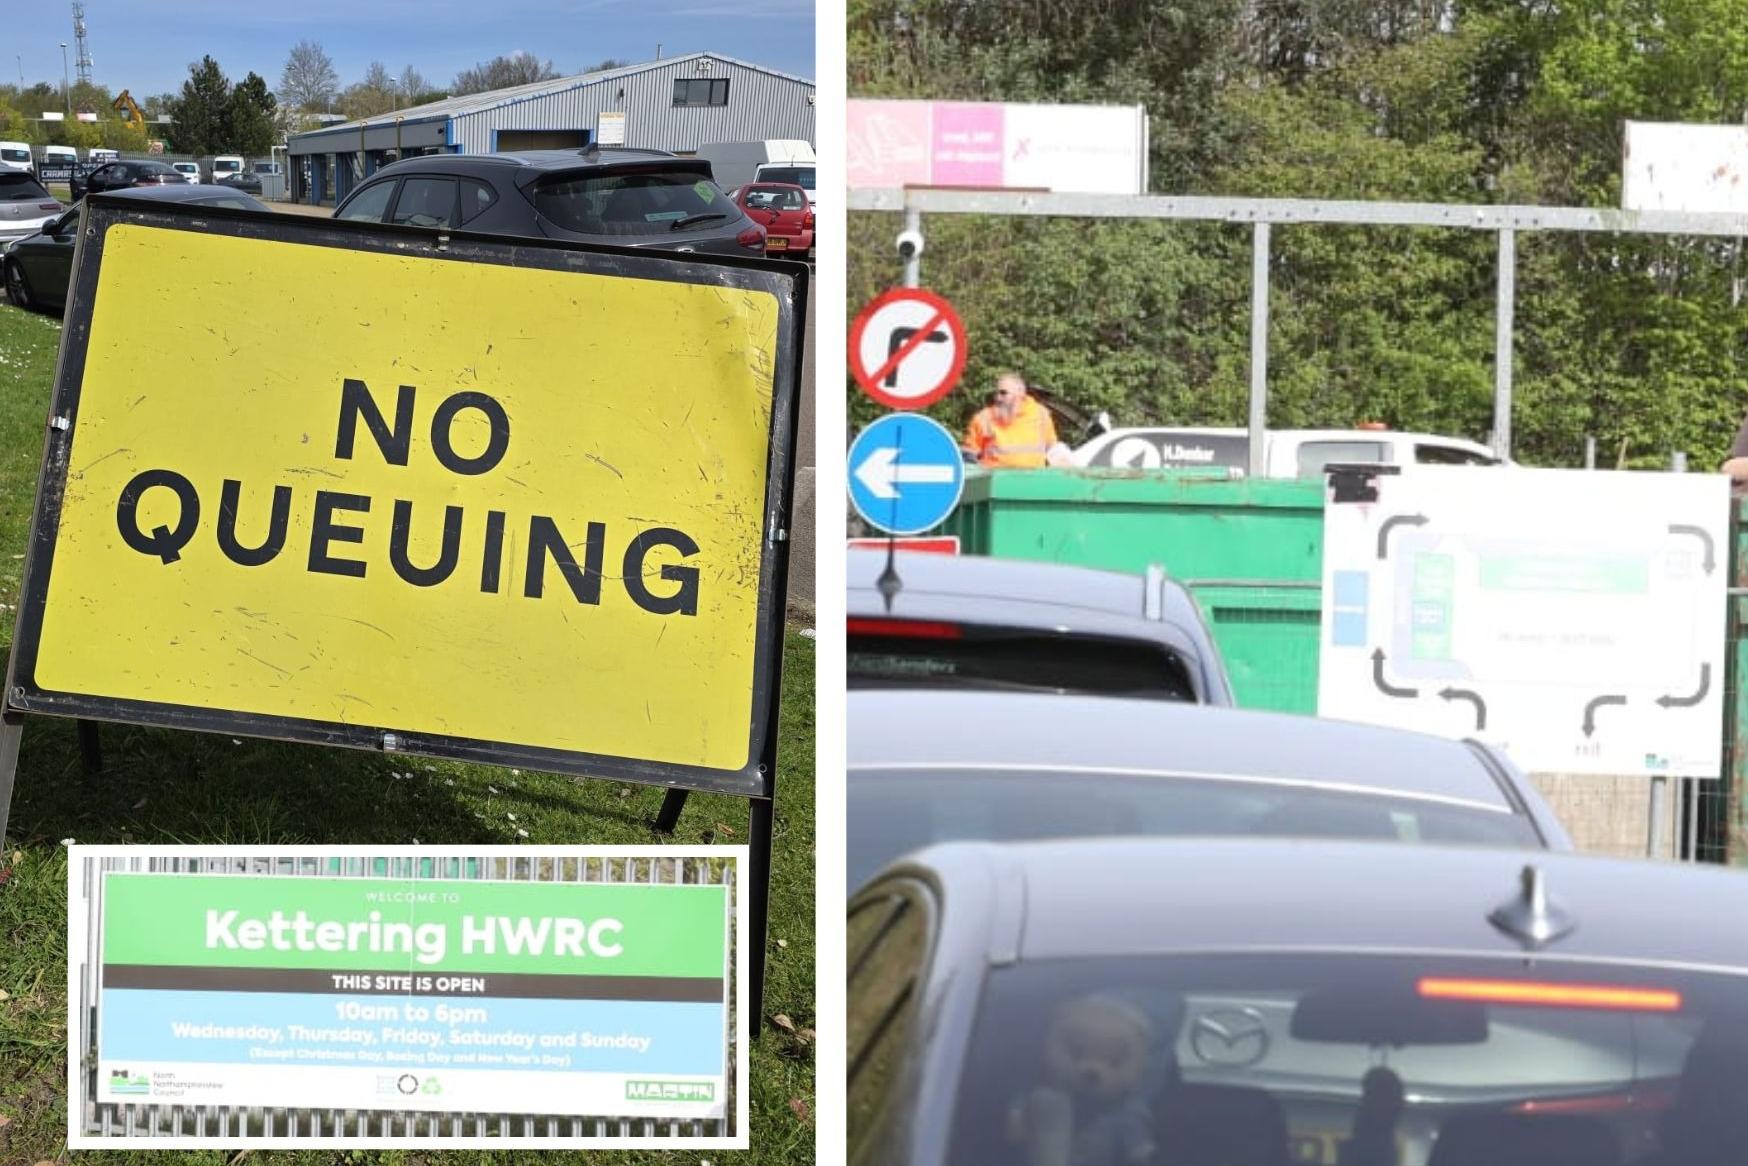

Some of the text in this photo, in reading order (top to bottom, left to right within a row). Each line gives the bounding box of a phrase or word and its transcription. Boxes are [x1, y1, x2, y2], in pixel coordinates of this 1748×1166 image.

[335, 378, 511, 476] NO
[116, 468, 701, 616] QUEUING
[367, 892, 459, 905] WELCOME TO
[206, 909, 624, 965] Kettering HWRC
[333, 975, 485, 991] THIS SITE IS OPEN
[336, 1001, 488, 1027] 10am to 6pm
[172, 1021, 652, 1053] Wednesday, Thursday, Friday, Saturday and Sunday
[249, 1047, 295, 1060] (Except
[297, 1047, 354, 1060] Christmas
[356, 1049, 384, 1062] Day,
[386, 1051, 426, 1064] Boxing
[427, 1052, 451, 1065] Day
[453, 1053, 475, 1063] and
[478, 1054, 504, 1064] New
[541, 1055, 573, 1067] Day)
[628, 1083, 713, 1099] MARTIN
